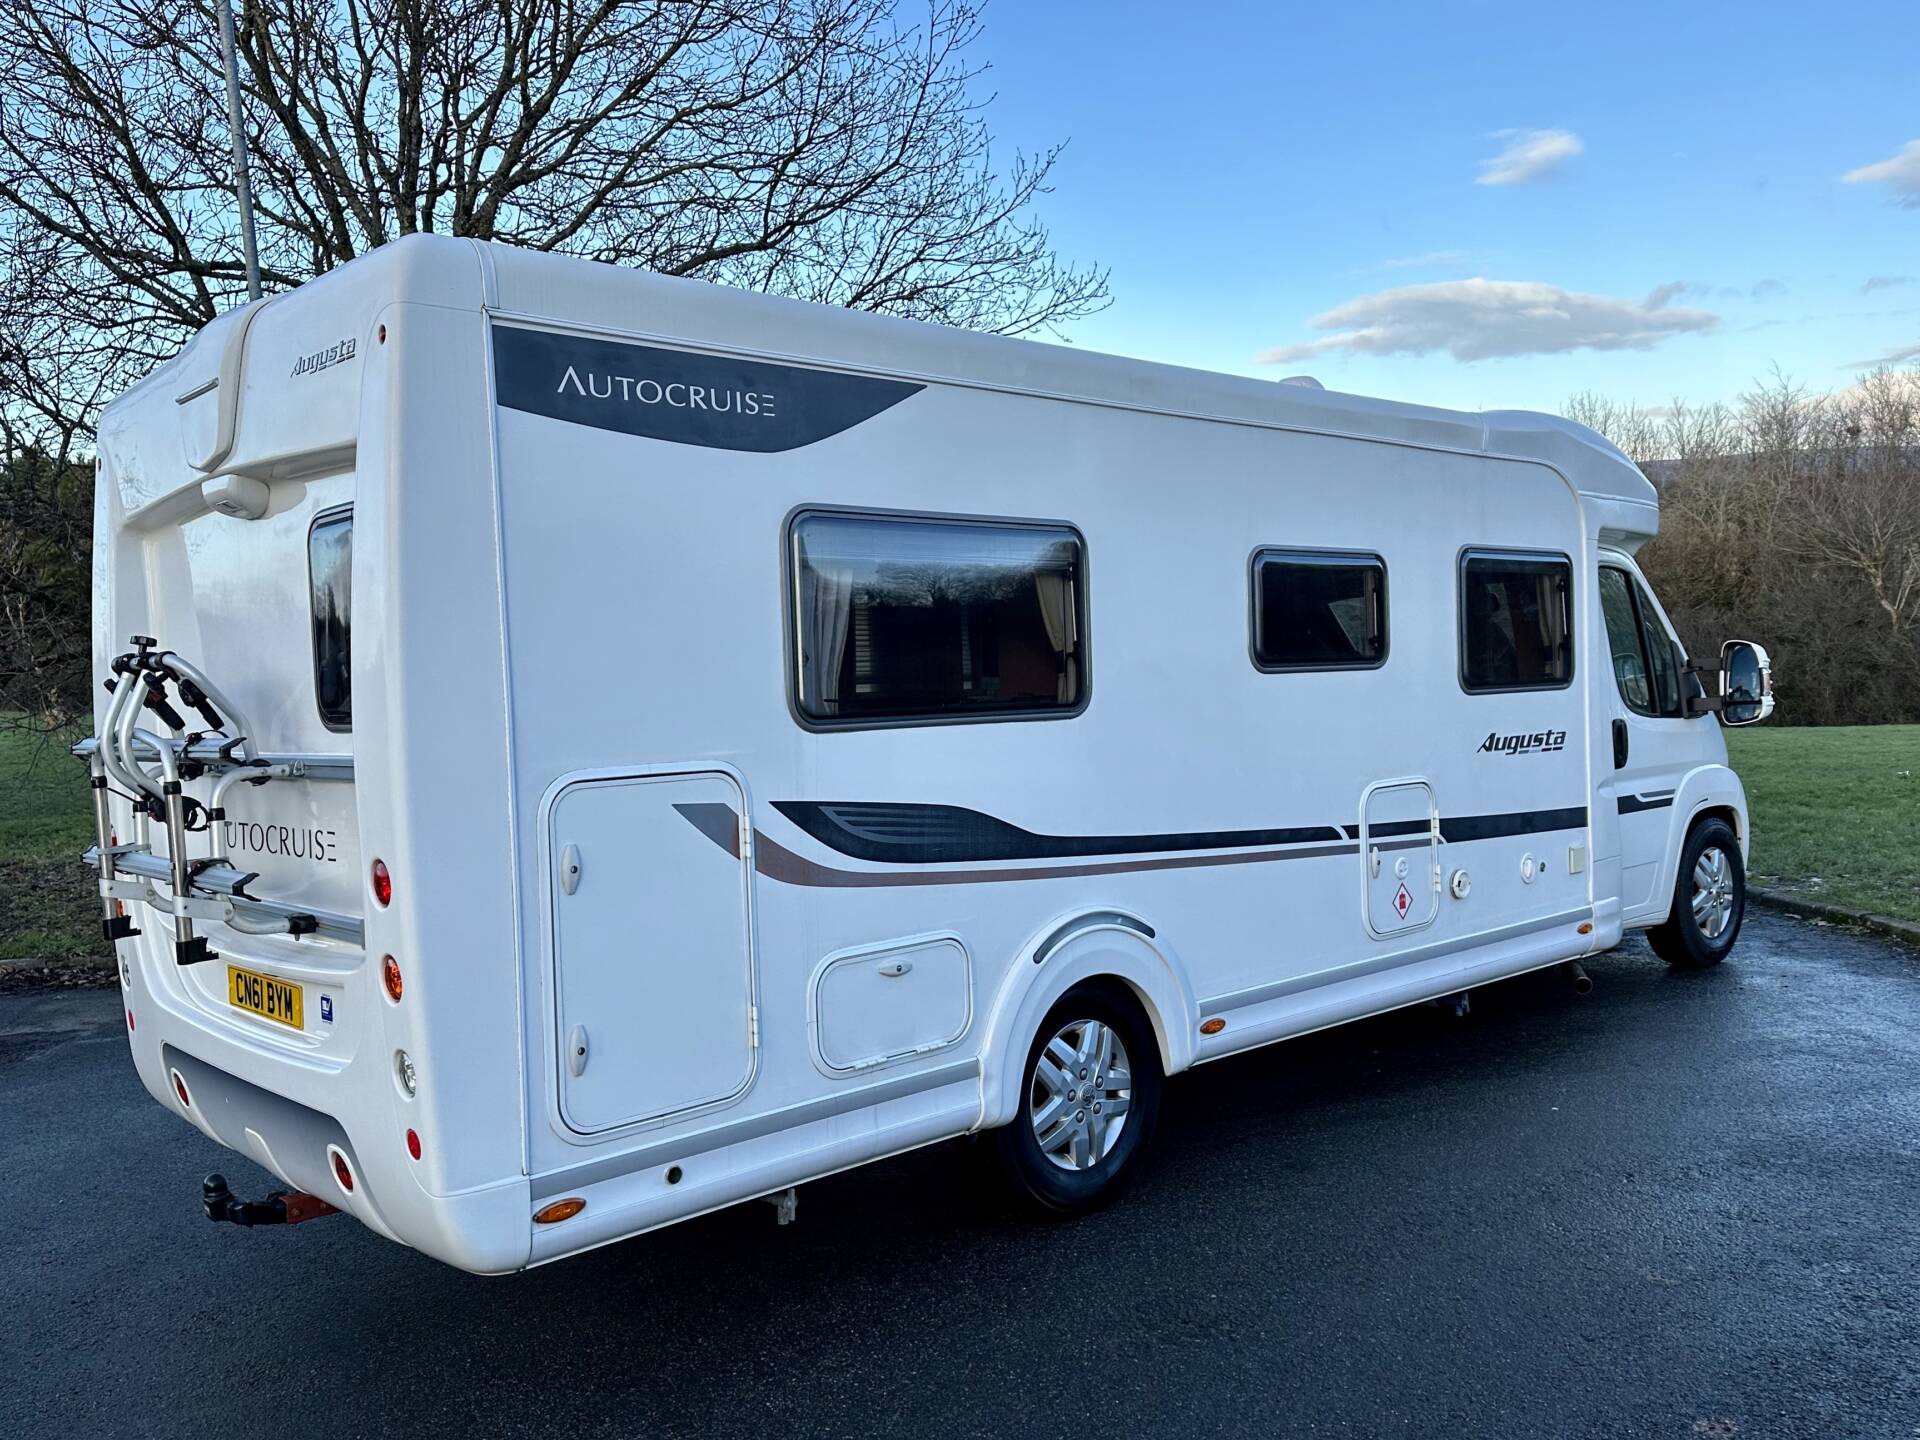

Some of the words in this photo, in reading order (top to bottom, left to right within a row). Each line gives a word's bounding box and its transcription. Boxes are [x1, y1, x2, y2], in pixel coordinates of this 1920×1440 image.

[289, 337, 356, 378] Augusta
[557, 365, 776, 417] AUTOCRUISE
[1476, 729, 1567, 756] Augusta
[225, 821, 337, 862] UTOCRUISE
[235, 972, 264, 1011] CN61
[266, 981, 294, 1021] BYM
